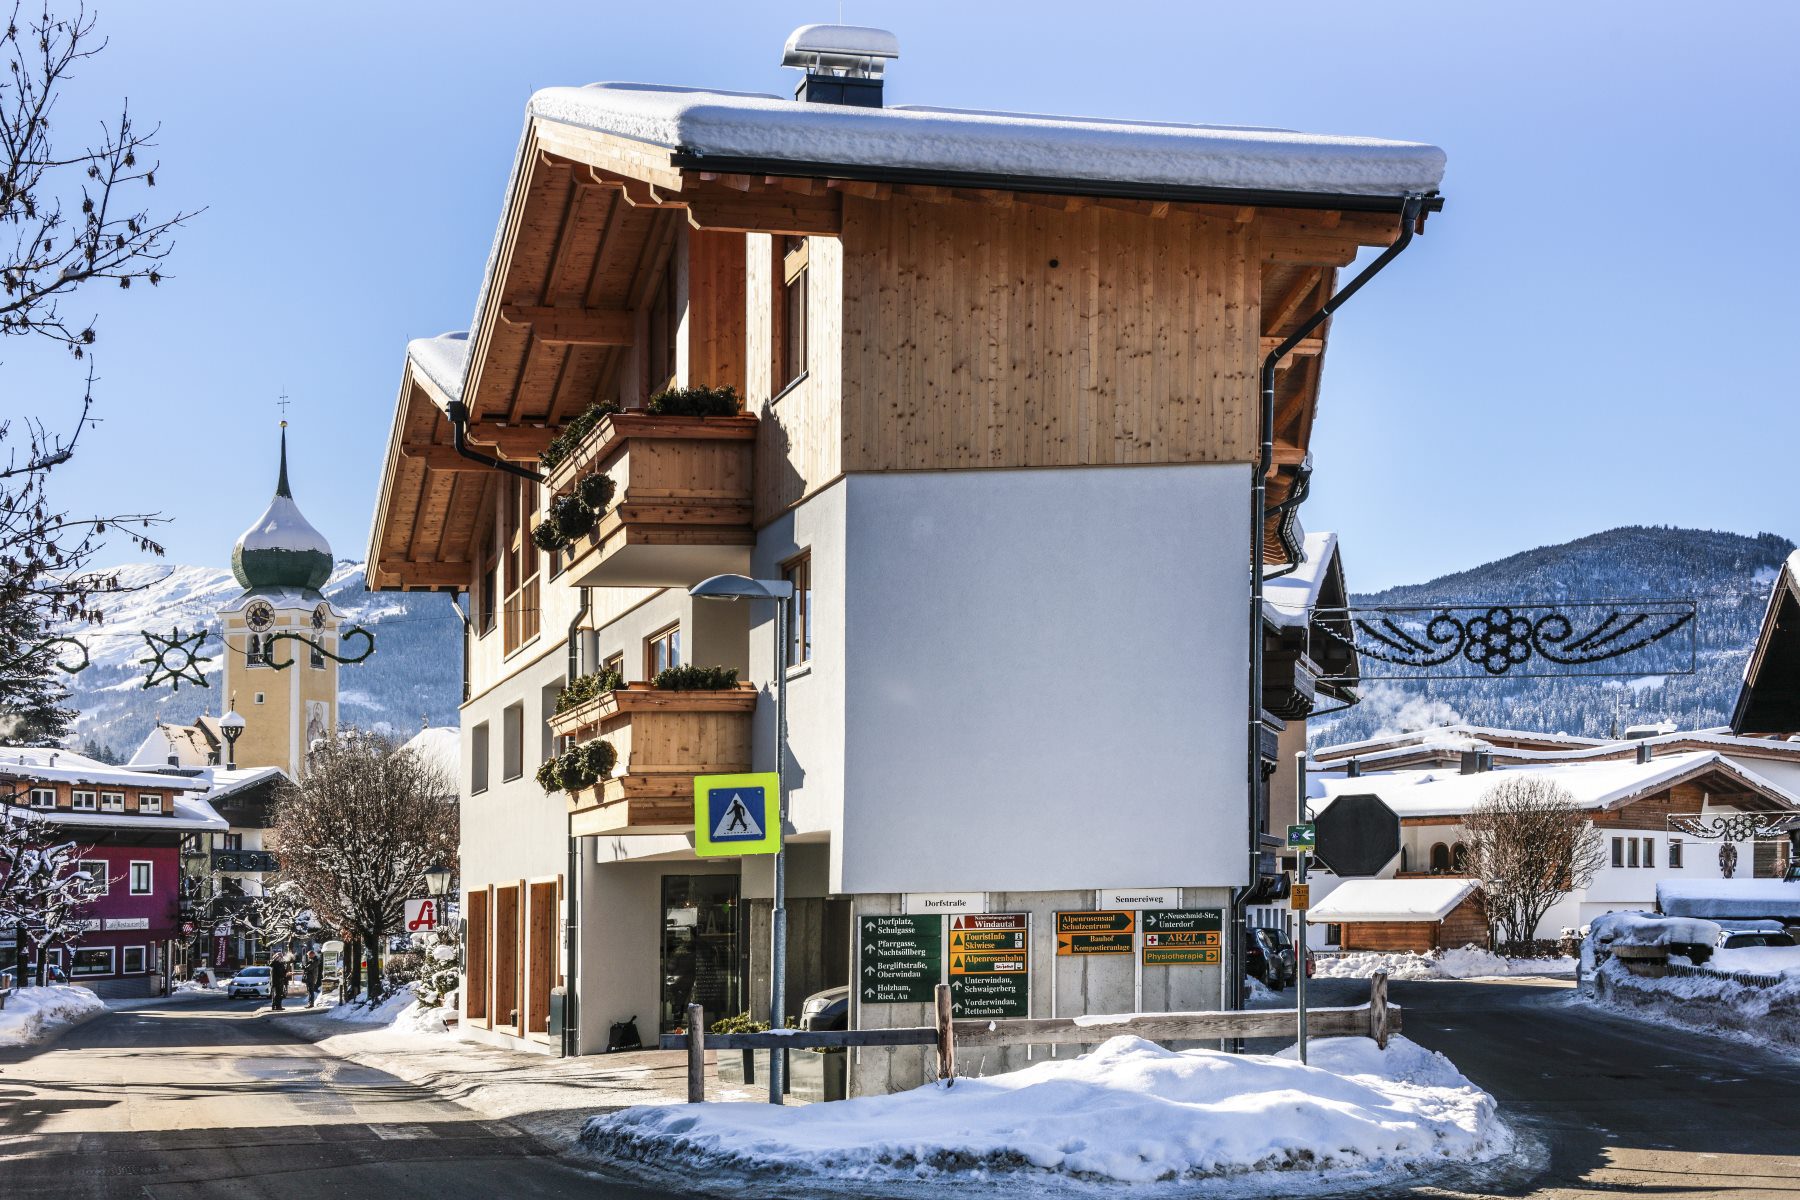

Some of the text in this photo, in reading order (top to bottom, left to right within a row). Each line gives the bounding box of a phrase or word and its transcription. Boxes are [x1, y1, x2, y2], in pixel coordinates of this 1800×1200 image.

[925, 899, 967, 907] Dorfstraße
[1115, 895, 1164, 904] Sennereiweg
[877, 918, 914, 926] Dorfplatz,
[1062, 914, 1116, 924] Alpenrosensaal
[974, 920, 1016, 928] Windautal
[1062, 923, 1111, 931] Schulzentrum
[1159, 920, 1195, 928] Unterdorf
[877, 926, 916, 935] Schulgasse
[1167, 933, 1198, 942] ARZT
[877, 940, 917, 949] Pfarrgasse,
[965, 942, 995, 950] Skiwiese
[1073, 944, 1130, 952] Kompostieranlage
[877, 948, 926, 957] Nachtsöllberg
[965, 955, 1024, 964] Alpenrosenbahn
[1147, 953, 1204, 961] Physiotherapie
[877, 961, 928, 970] Bergliftstraße,
[877, 970, 921, 978] Oberwindau
[964, 976, 1013, 984] Unterwindau,
[877, 984, 911, 992] Holzham,
[964, 985, 1016, 993] Schwaigerberg
[877, 993, 896, 1001] Ried,
[964, 998, 1017, 1006] Vorderwindau,
[964, 1007, 1004, 1015] Rettenbach
